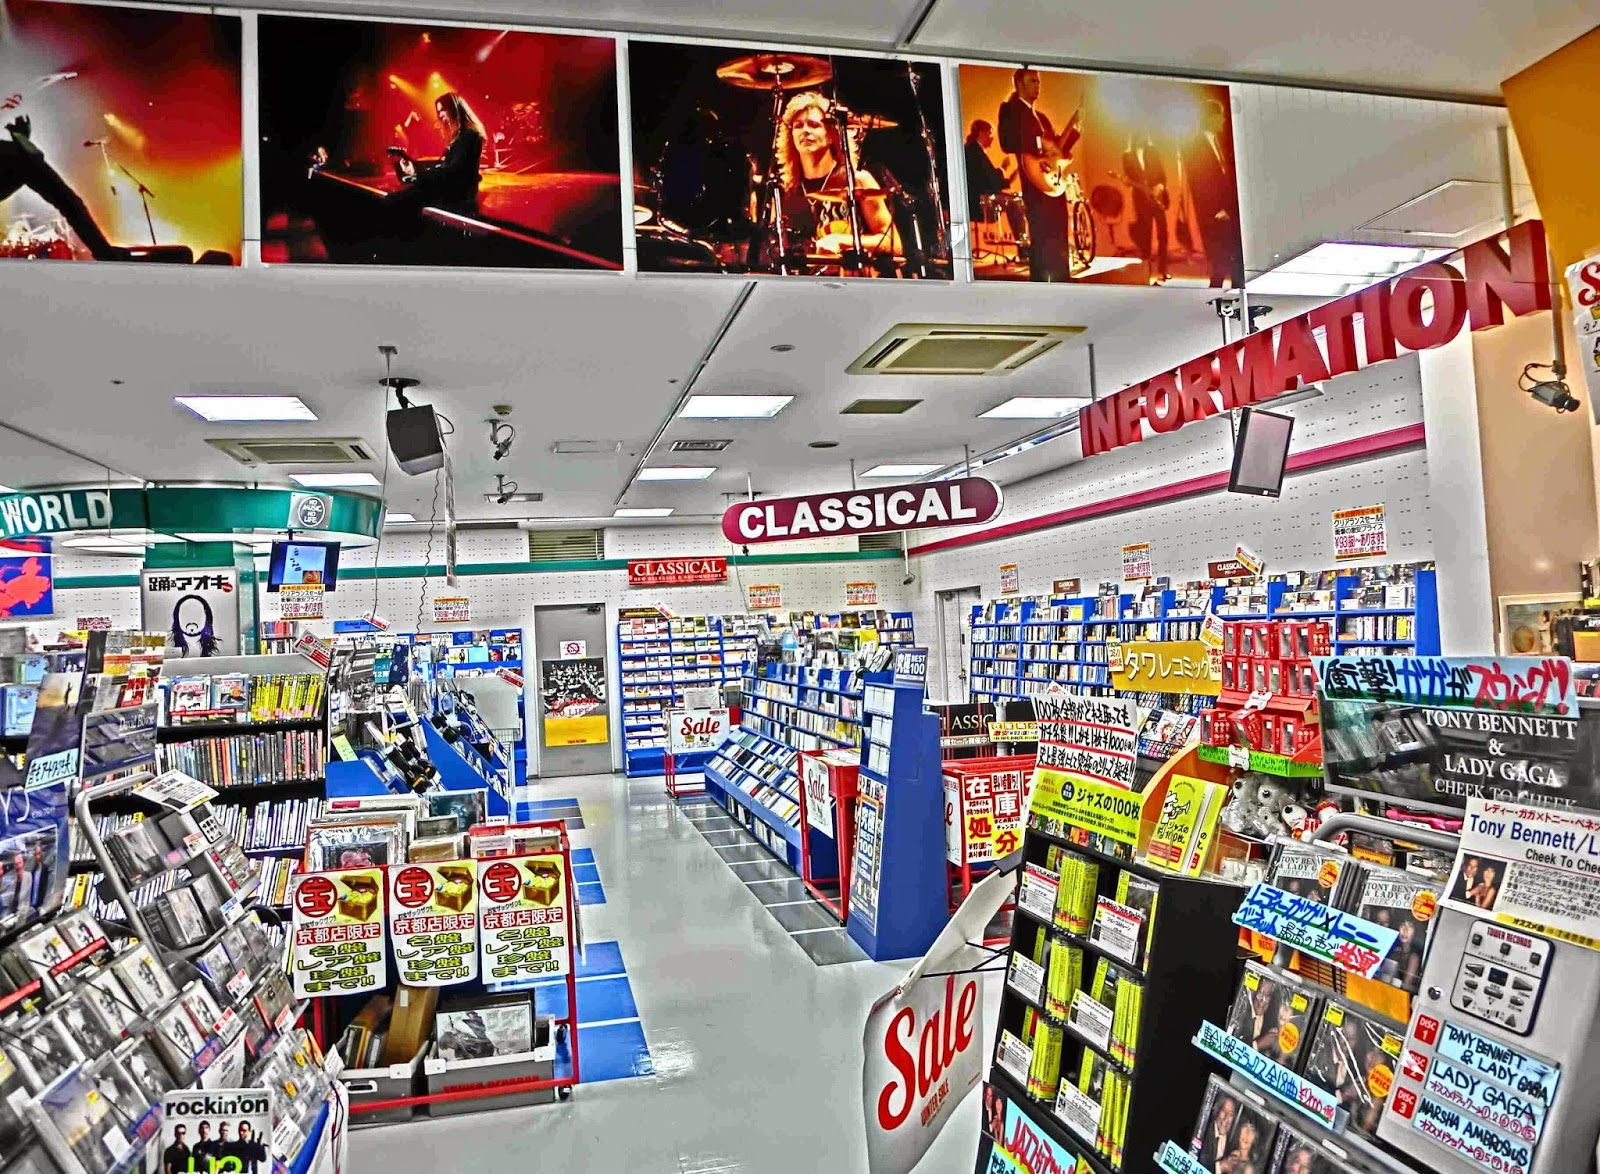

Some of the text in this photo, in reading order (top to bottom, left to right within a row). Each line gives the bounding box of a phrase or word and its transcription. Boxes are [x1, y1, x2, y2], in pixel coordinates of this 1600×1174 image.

[1080, 219, 1552, 457] INFORMATION
[1, 491, 113, 535] WORLD
[738, 484, 977, 540] CLASSICAL
[634, 561, 722, 576] CLASSICAL
[148, 576, 230, 593] 踊るアオキ
[911, 663, 925, 675] 100
[681, 717, 720, 735] Sale
[1422, 709, 1578, 740] TONY BENNETT
[1488, 739, 1507, 756] &
[1444, 754, 1562, 787] LADY GAGA
[807, 768, 826, 804] Sale
[965, 776, 992, 799] 在
[1434, 779, 1486, 799] CHEEK
[994, 792, 1018, 816] 庫
[1077, 788, 1140, 820] ジャズの100枚
[968, 817, 993, 839] 処
[1470, 814, 1600, 856] Tony Bennett/L
[859, 840, 873, 857] 100
[995, 831, 1019, 854] 分
[1287, 863, 1308, 871] LADY
[1526, 849, 1556, 865] Cheek
[1561, 855, 1573, 868] To
[1367, 882, 1389, 892] TONY
[1375, 891, 1399, 900] LADY
[394, 914, 475, 934] 京都店限定
[484, 908, 563, 929] 京都店限定
[297, 923, 380, 944] 京都店限定
[1487, 927, 1506, 940] TOWER
[1506, 933, 1533, 949] RECORDS
[1420, 1018, 1437, 1031] DISC
[878, 971, 976, 1130] Sale
[1447, 1024, 1527, 1069] TONY BENNETT
[1460, 1050, 1473, 1065] &
[1478, 1058, 1518, 1086] LADY
[1397, 1090, 1415, 1105] DISC
[1433, 1061, 1536, 1126] LADY GAGA
[165, 1095, 269, 1116] rockin'on
[1418, 1098, 1460, 1131] MARSHA
